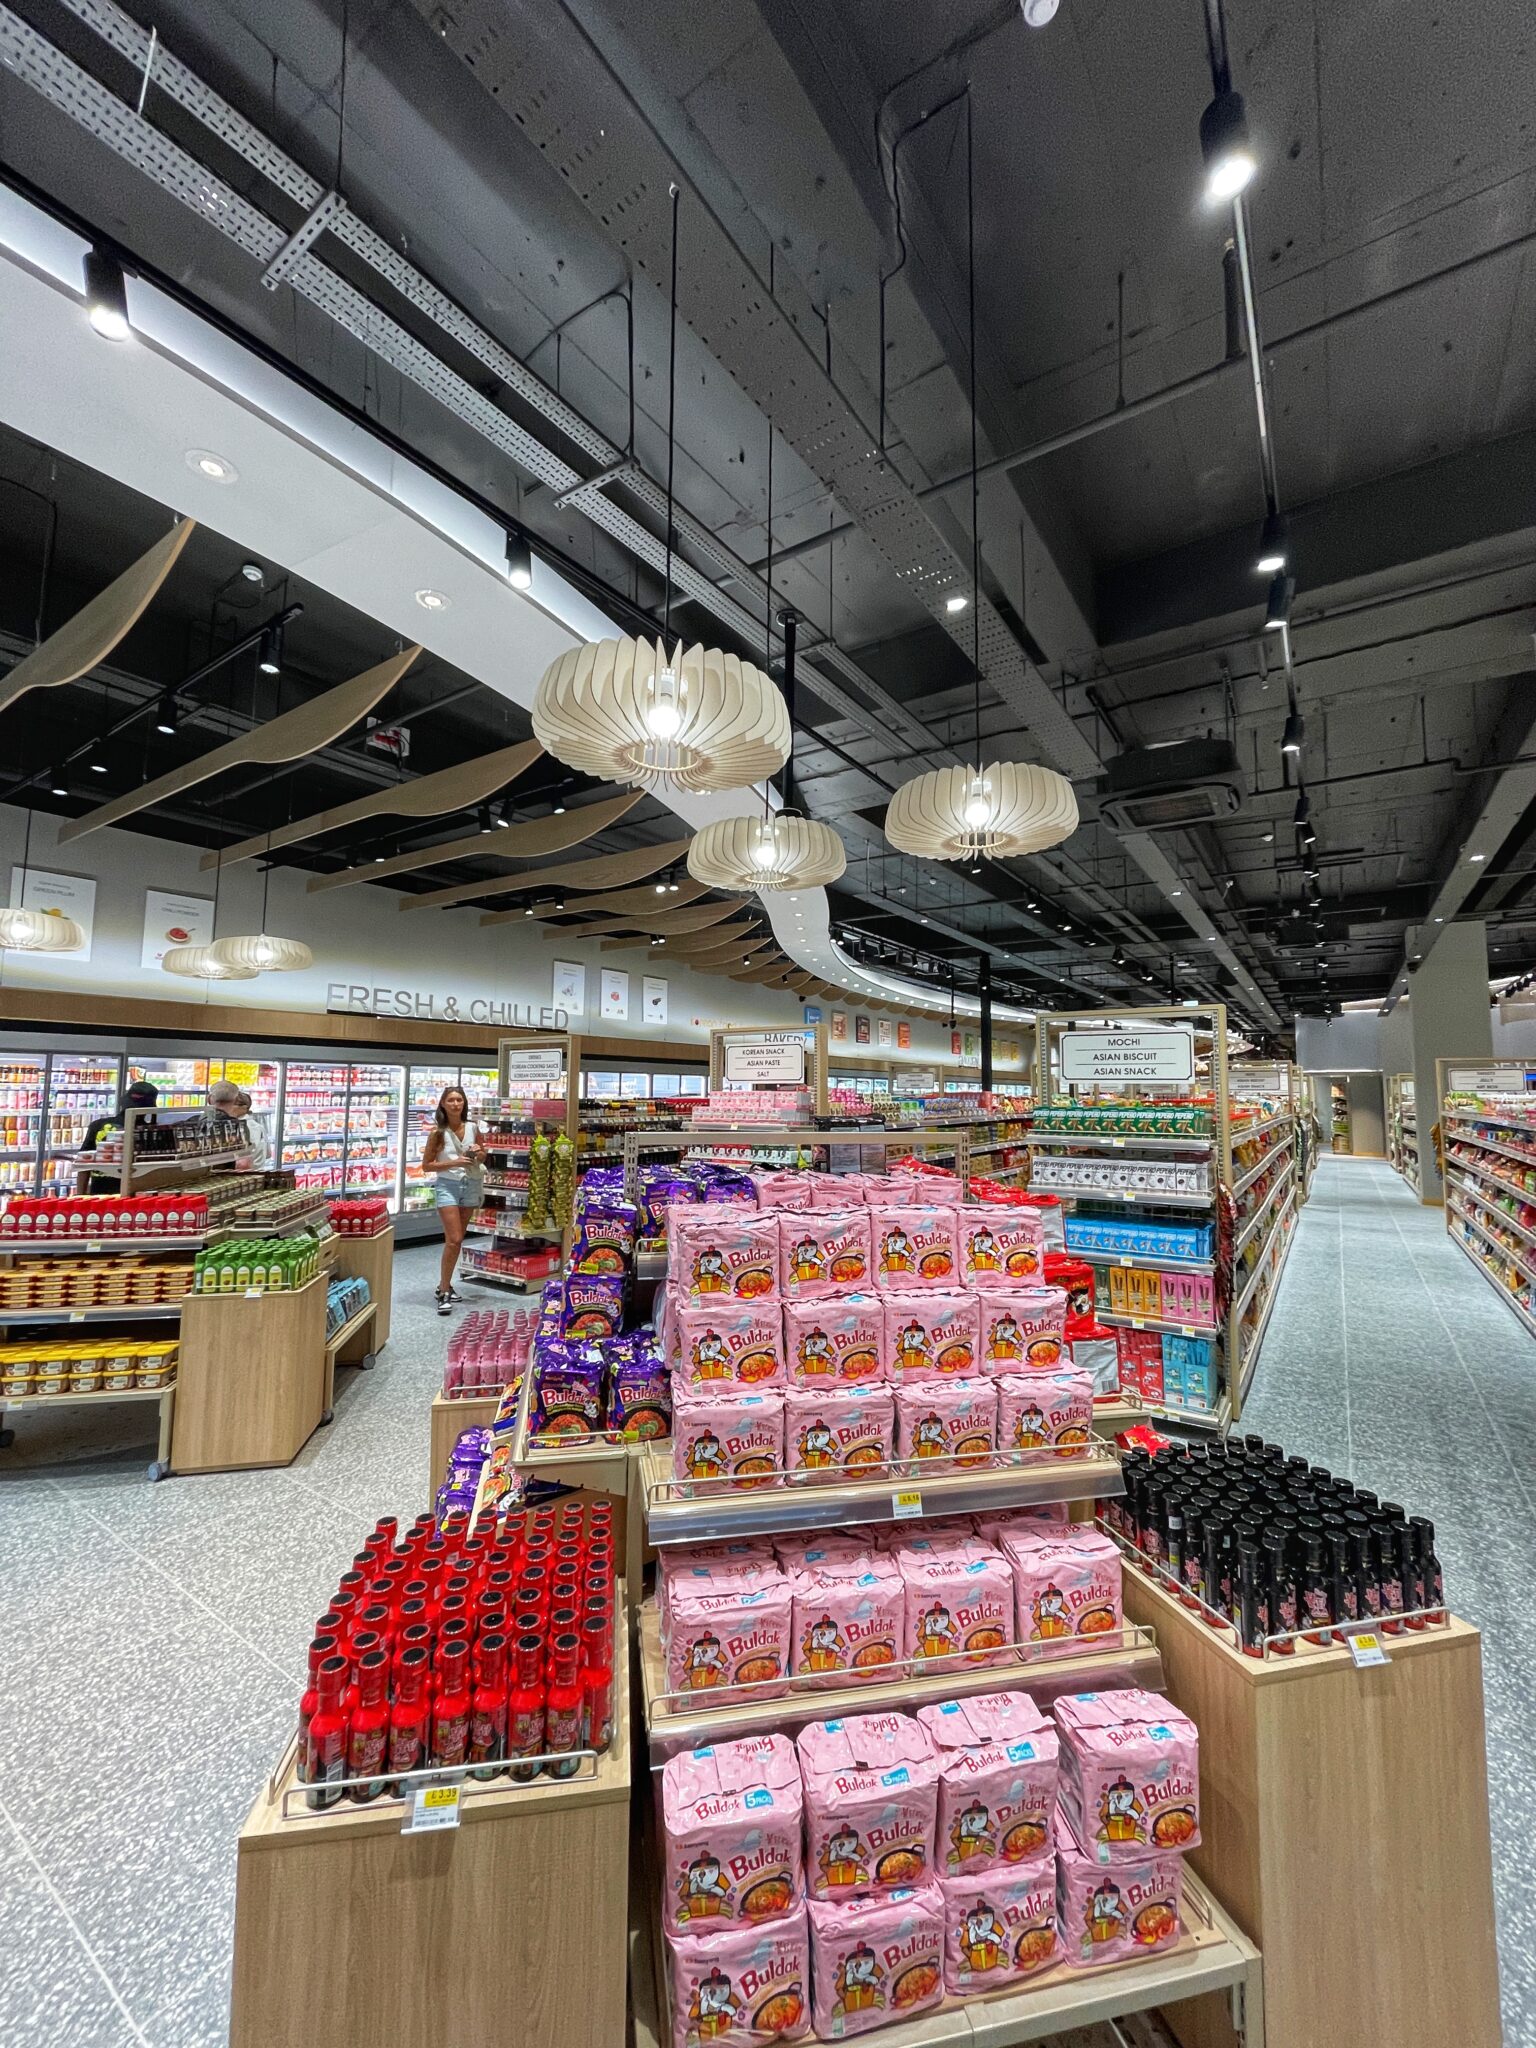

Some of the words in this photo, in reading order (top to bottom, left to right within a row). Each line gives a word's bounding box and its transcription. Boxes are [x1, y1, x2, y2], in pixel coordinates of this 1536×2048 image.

[327, 983, 435, 1019] FRESH
[442, 996, 461, 1024] &
[470, 999, 569, 1030] CHILLED
[1108, 1038, 1141, 1047] MOCHI
[1093, 1053, 1121, 1061] ASIAN
[1124, 1052, 1157, 1061] BISCUIT
[1093, 1067, 1122, 1076] ASIAN
[1124, 1067, 1157, 1076] SNACK
[823, 1237, 864, 1257] Buldak
[912, 1232, 951, 1250] Buldak
[998, 1232, 1035, 1249] Buldak
[728, 1249, 772, 1269] Buldak
[931, 1324, 971, 1343] Buldak
[1022, 1320, 1061, 1337] Buldak
[728, 1330, 774, 1351] Buldak
[834, 1330, 877, 1350] Buldak
[541, 1389, 585, 1406] Buldak
[949, 1415, 991, 1436] Buldak
[1049, 1407, 1089, 1427] Buldak
[726, 1434, 775, 1456] Buldak
[837, 1424, 883, 1446] Buldak
[1068, 1585, 1113, 1608] Buldak
[956, 1603, 1003, 1628] Buldak
[844, 1618, 895, 1643] Buldak
[727, 1630, 780, 1658] Buldak
[965, 1752, 1004, 1773] Buldak
[834, 1777, 877, 1794] Buldak
[1141, 1779, 1194, 1806] Buldak
[696, 1800, 740, 1820] Buldak
[996, 1798, 1048, 1824] Buldak
[867, 1821, 925, 1849] Buldak
[728, 1850, 791, 1882] Buldak
[1127, 1876, 1175, 1907] Buldak
[1002, 1893, 1053, 1926] Buldak
[883, 1935, 940, 1969] Buldak
[739, 1955, 800, 2000] Buldak
